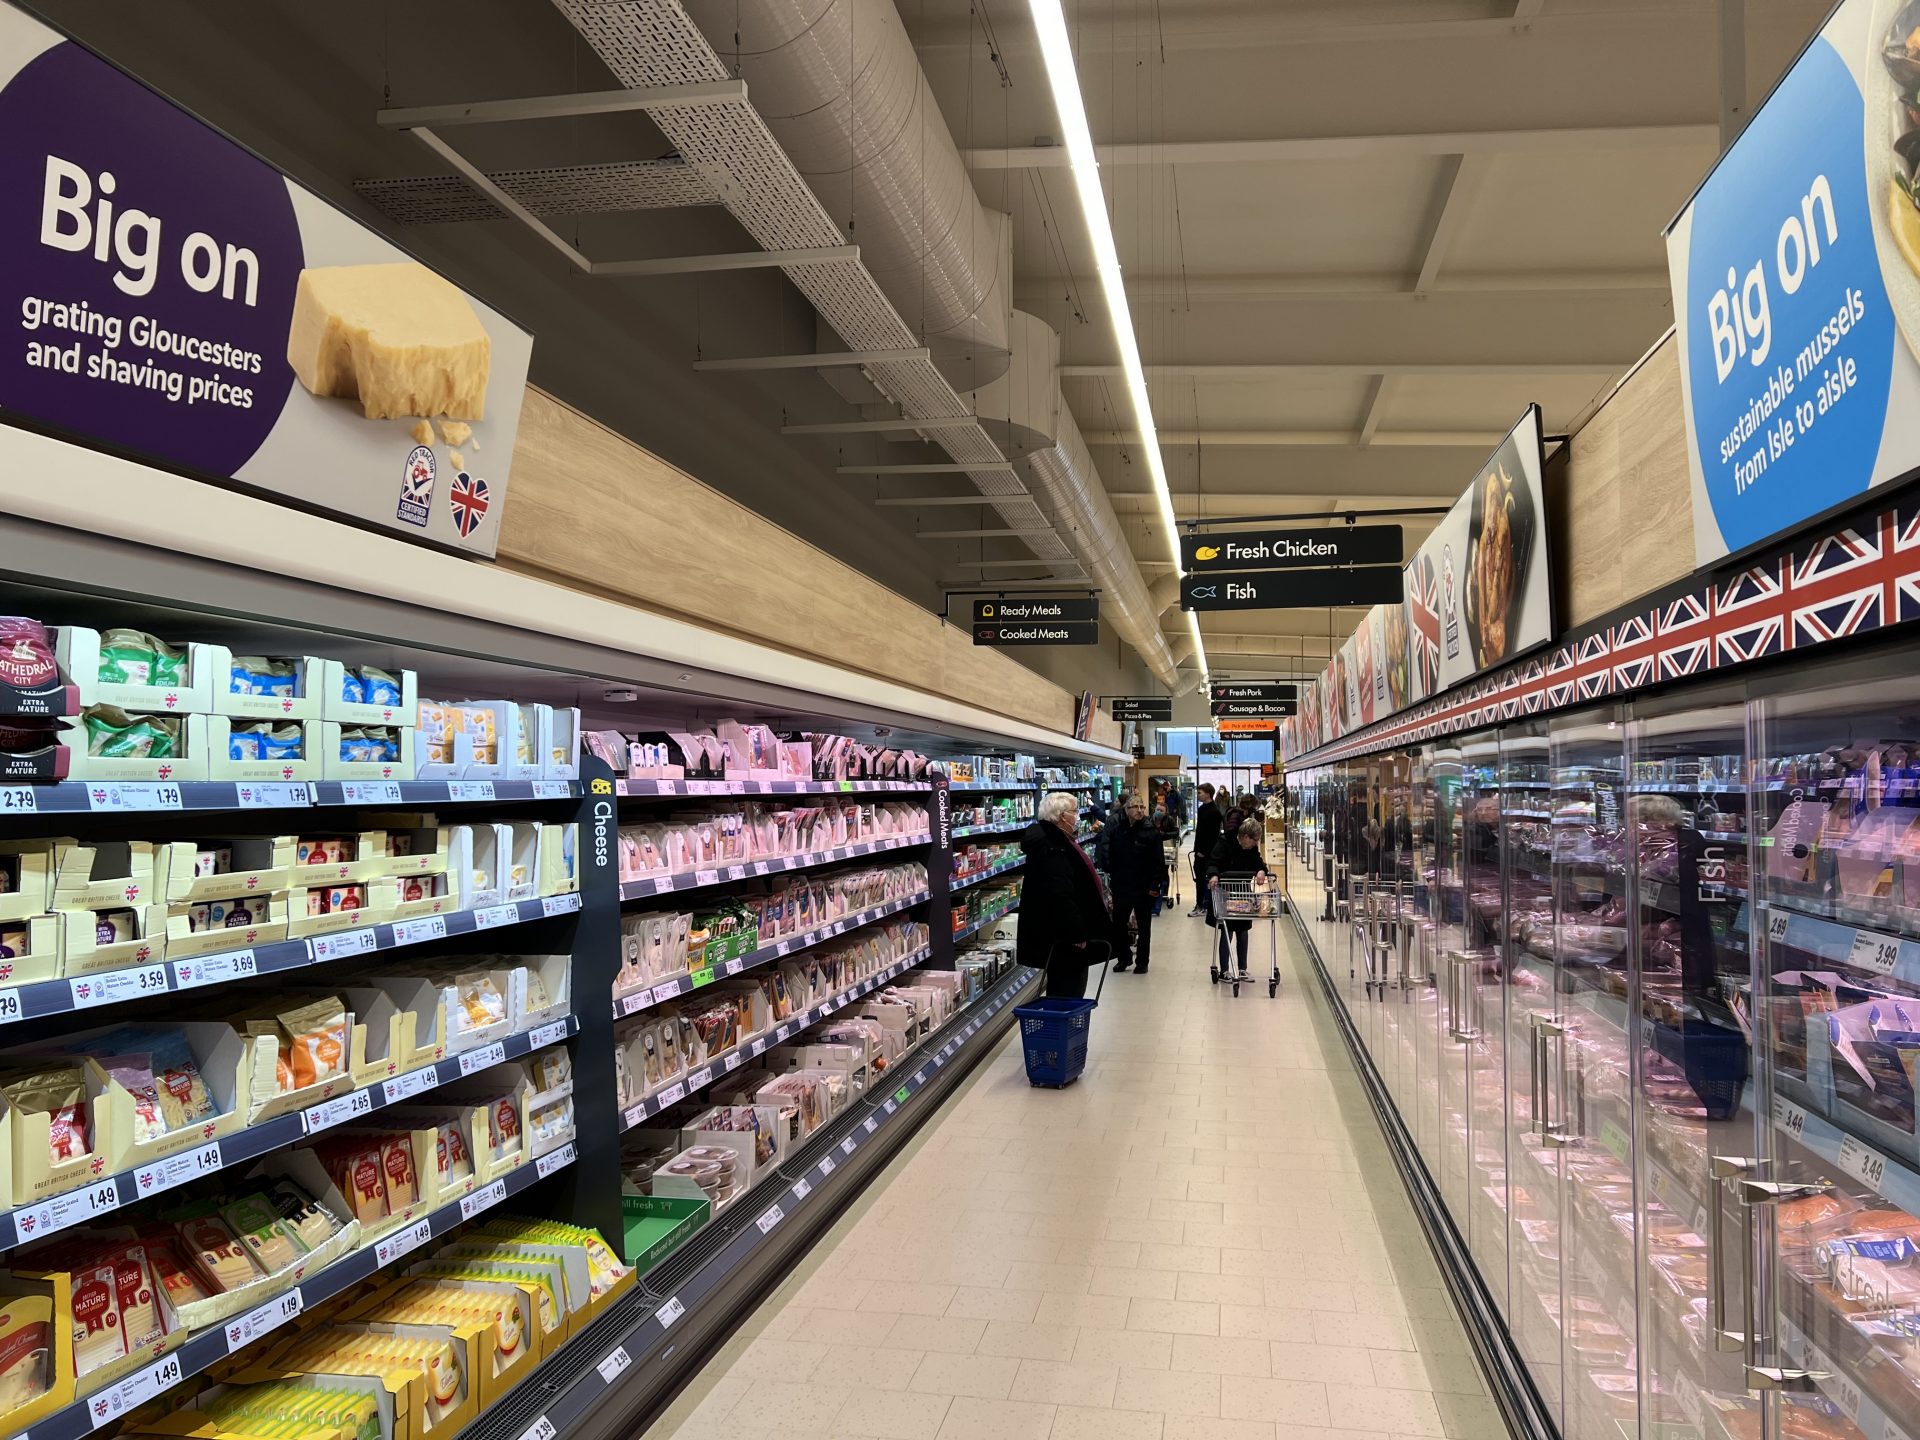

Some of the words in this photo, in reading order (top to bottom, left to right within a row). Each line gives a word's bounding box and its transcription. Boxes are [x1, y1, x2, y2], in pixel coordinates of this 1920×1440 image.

[40, 155, 161, 296] Big
[181, 231, 260, 307] on
[1708, 258, 1772, 385] Big
[1777, 174, 1838, 295] on
[22, 297, 122, 347] grating
[129, 316, 262, 374] Gloucesters
[26, 339, 80, 374] and
[87, 348, 181, 401] shaving
[188, 375, 253, 408] prices
[1720, 364, 1794, 464] sustainable
[1796, 286, 1865, 383] mussels
[1734, 450, 1767, 495] from
[1768, 413, 1794, 467] Isle
[1795, 399, 1814, 435] to
[1818, 356, 1858, 419] aisle
[408, 450, 419, 466] RED
[419, 449, 434, 474] TRACTOR
[401, 501, 427, 516] CERTIFIED
[397, 509, 426, 525] STANDARDS
[1227, 541, 1270, 560] Fresh
[1273, 538, 1338, 558] Chicken
[1227, 582, 1257, 600] Fish
[1000, 605, 1031, 618] Ready
[1032, 604, 1061, 616] Meals
[999, 628, 1037, 639] Cooked
[1038, 628, 1069, 638] Meats
[0, 659, 53, 676] ATHEDRAL
[13, 676, 32, 685] CITY
[1229, 688, 1246, 696] Fresh
[1247, 688, 1262, 696] Pork
[17, 705, 50, 713] MATURE
[22, 698, 45, 706] EXTRA
[1229, 704, 1257, 714] Sausage
[1264, 704, 1286, 712] Bacon
[5, 767, 38, 775] MATURE
[157, 788, 178, 804] 1.79
[289, 788, 306, 801] 1.79
[384, 786, 399, 798] 1.79
[480, 785, 493, 796] 3.99
[3, 791, 34, 808] 2.79
[938, 789, 949, 822] Cooked
[594, 801, 612, 867] Cheese
[940, 822, 949, 849] Meats
[1696, 846, 1726, 902] Fish
[506, 908, 517, 919] 1.79
[431, 921, 444, 933] 1.79
[1770, 917, 1787, 936] 2.69
[359, 934, 374, 947] 1.79
[1875, 943, 1897, 967] 3.99
[232, 955, 253, 972] 3.69
[139, 970, 164, 988] 3.59
[555, 1024, 566, 1036] 2.49
[490, 1047, 504, 1060] 2.49
[421, 1071, 436, 1085] 1.49
[170, 1080, 191, 1093] MATURE
[351, 1094, 369, 1112] 2.65
[1786, 1110, 1803, 1133] 3.49
[156, 1144, 169, 1153] GREAT
[170, 1139, 185, 1149] BRITISH
[197, 1149, 218, 1169] 1.49
[387, 1155, 405, 1168] MATURE
[562, 1148, 573, 1161] 1.49
[356, 1168, 375, 1181] MATURE
[1861, 1154, 1883, 1182] 3.49
[34, 1180, 50, 1190] GREAT
[50, 1174, 69, 1184] BRITISH
[69, 1168, 86, 1178] CHEESE
[89, 1186, 115, 1210] 1.49
[492, 1184, 504, 1199] 1.49
[52, 1202, 66, 1211] Mature
[66, 1198, 79, 1206] Grated
[53, 1208, 69, 1217] Cheddar
[622, 1200, 631, 1208] ill
[633, 1200, 653, 1209] fresh
[415, 1224, 429, 1242] 1.49
[118, 1271, 139, 1285] TURE
[75, 1293, 106, 1312] MATURE
[140, 1291, 149, 1299] 10
[281, 1296, 297, 1316] 1.19
[669, 1300, 682, 1314] 1.49
[92, 1320, 97, 1328] 4
[107, 1315, 116, 1323] 10
[614, 1351, 628, 1368] 2.39
[154, 1361, 178, 1386] 1.49
[122, 1383, 134, 1393] Mature
[135, 1376, 148, 1386] Cheddar
[535, 1421, 552, 1439] 2.39
